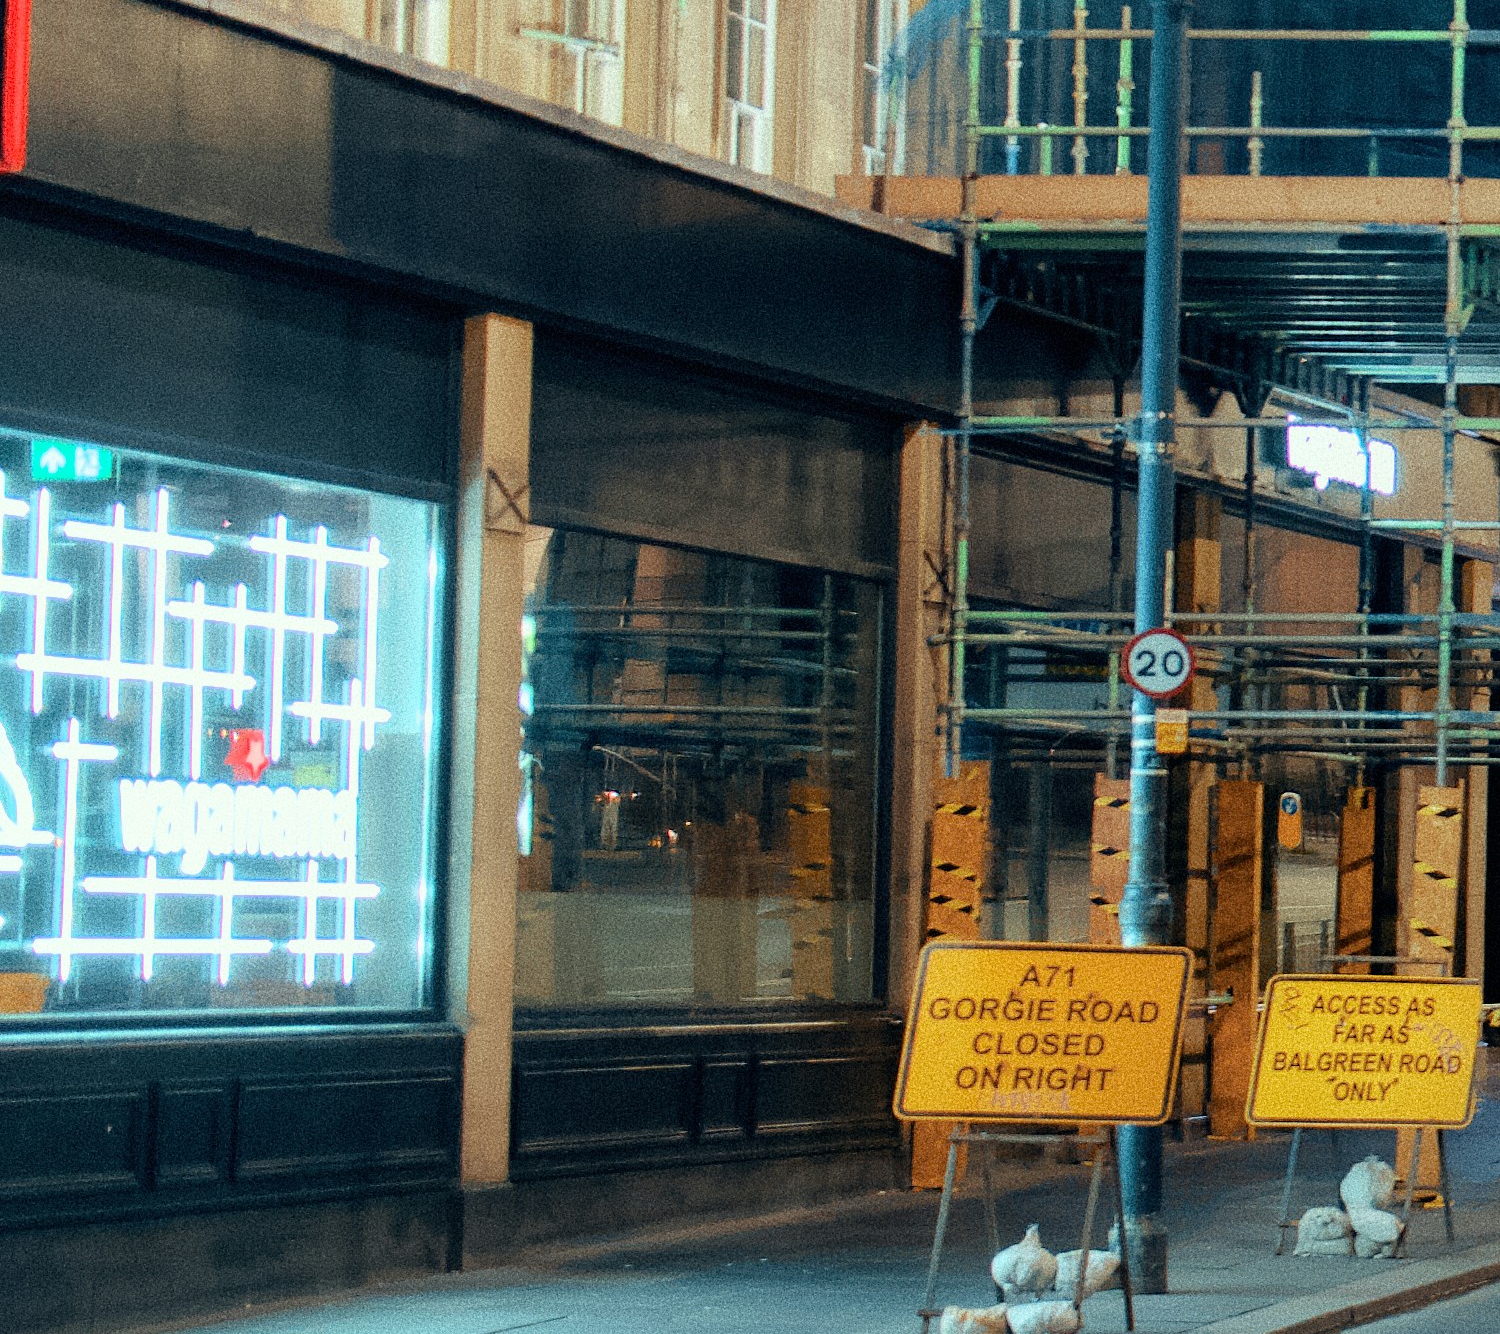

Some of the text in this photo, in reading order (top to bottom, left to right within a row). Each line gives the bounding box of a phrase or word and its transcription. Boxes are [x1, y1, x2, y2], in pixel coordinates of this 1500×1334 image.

[1136, 650, 1185, 677] 20
[1019, 965, 1076, 988] A71
[929, 997, 1160, 1024] GORGIE ROAD
[1311, 995, 1401, 1015] ACCESS
[1406, 997, 1437, 1017] AS
[973, 1032, 1106, 1056] CLOSED
[1332, 1024, 1376, 1044] FAR
[1380, 1025, 1411, 1045] AS
[1273, 1052, 1462, 1075] BALGREEN ROAD
[955, 1066, 1114, 1091] ON RIGHT
[1333, 1080, 1393, 1102] ONLY
